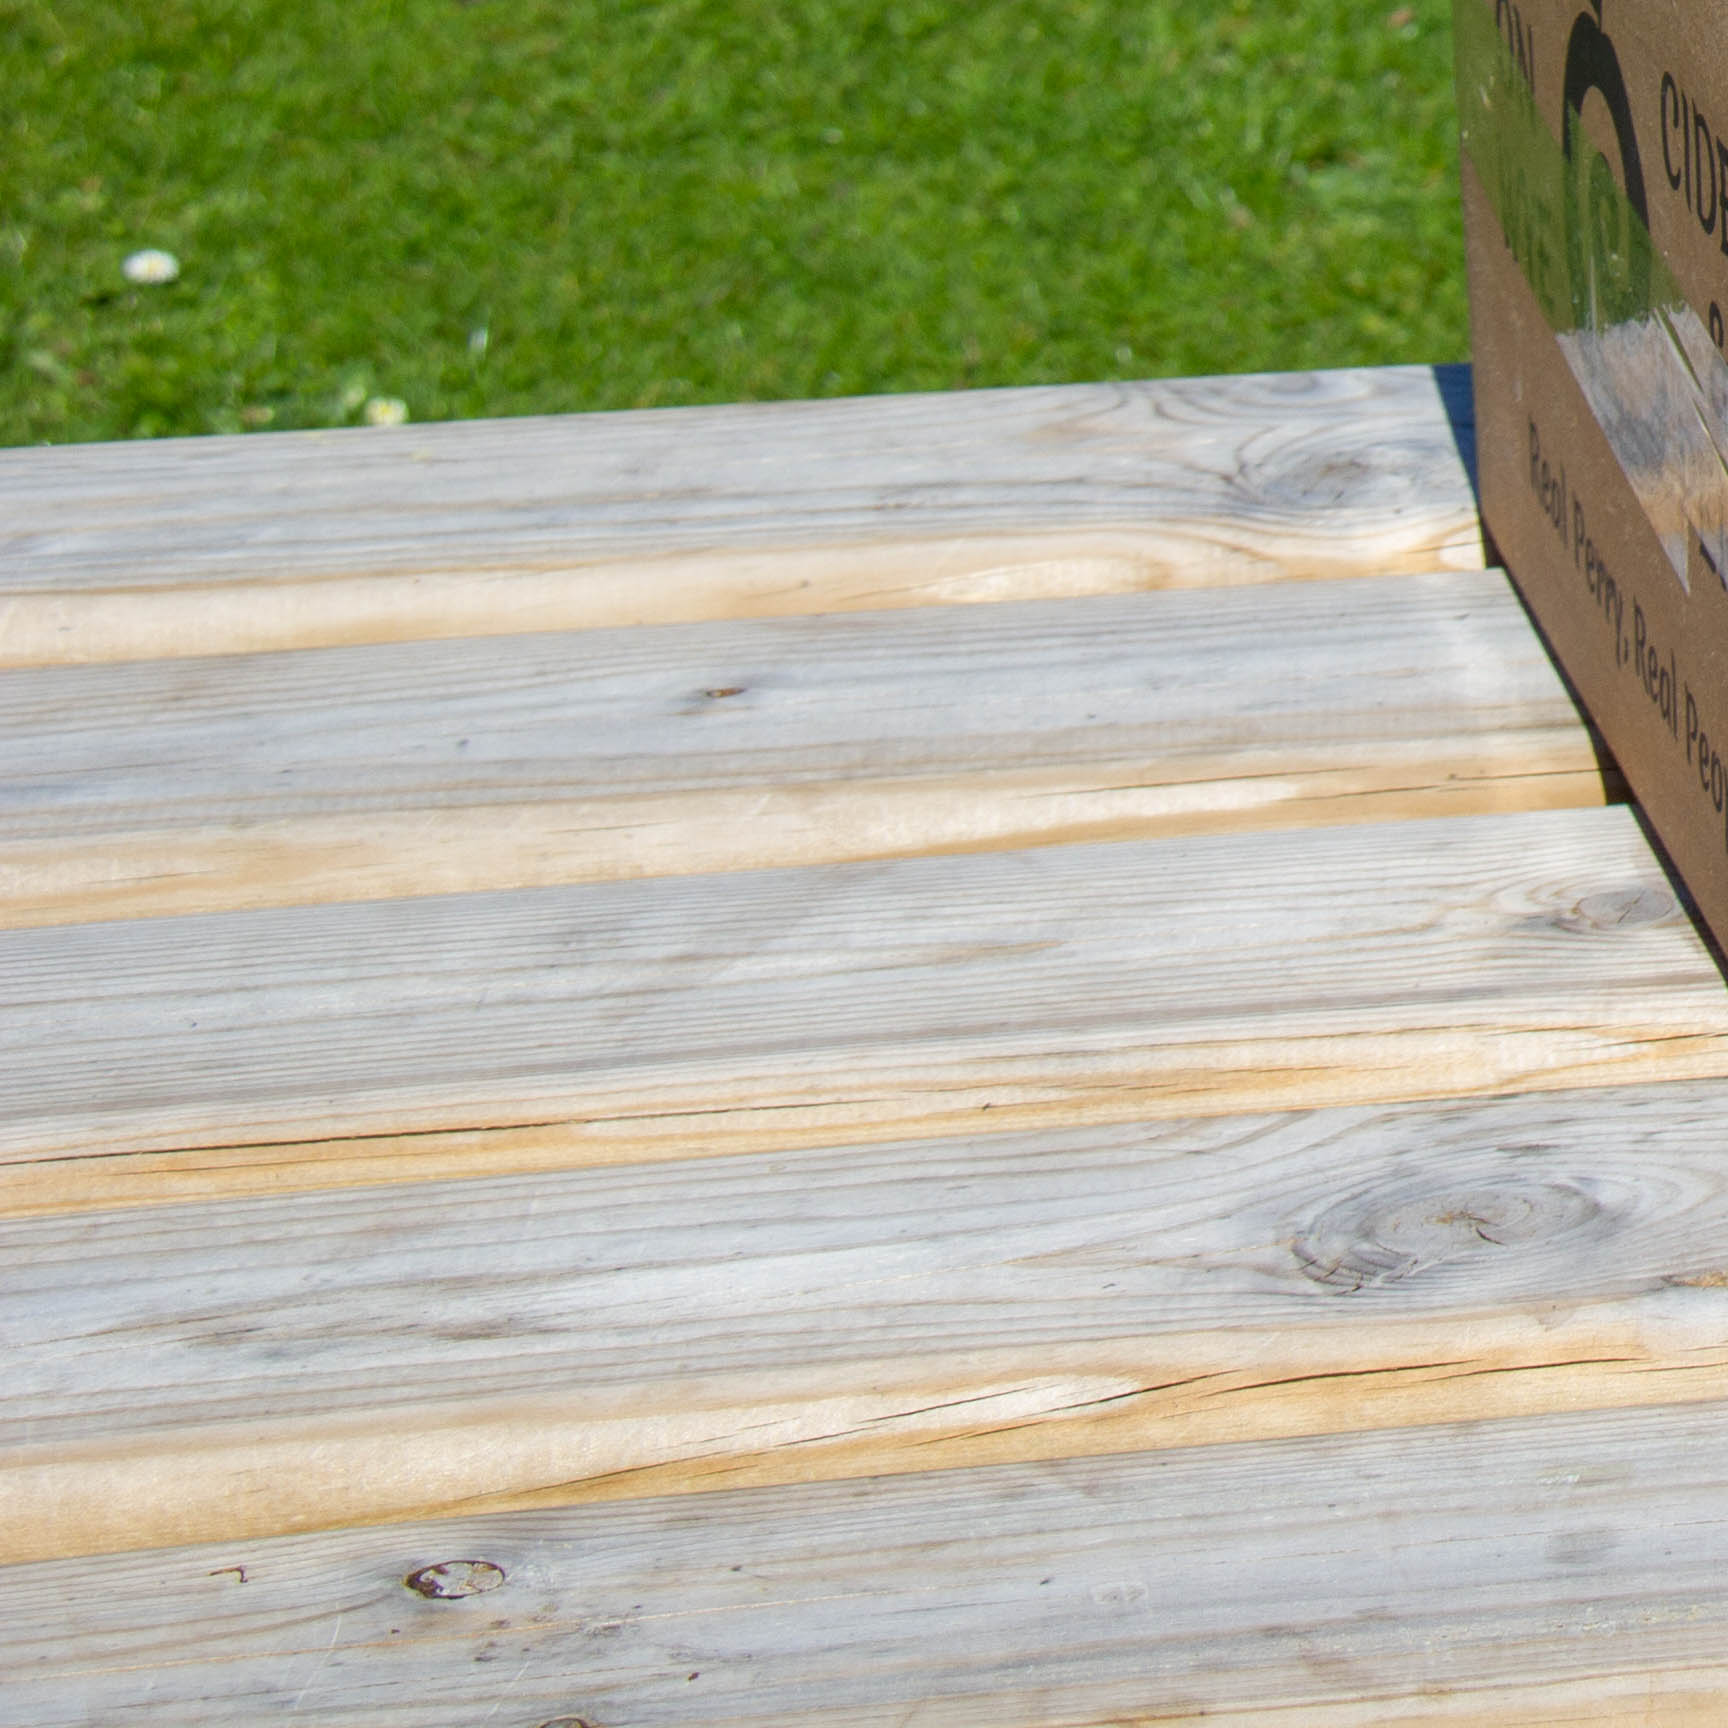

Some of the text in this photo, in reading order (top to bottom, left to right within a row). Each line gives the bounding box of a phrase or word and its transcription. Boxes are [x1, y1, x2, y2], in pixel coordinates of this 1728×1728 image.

[1528, 412, 1568, 549] Real
[1572, 490, 1630, 669] Perry,
[1633, 593, 1679, 742] Real
